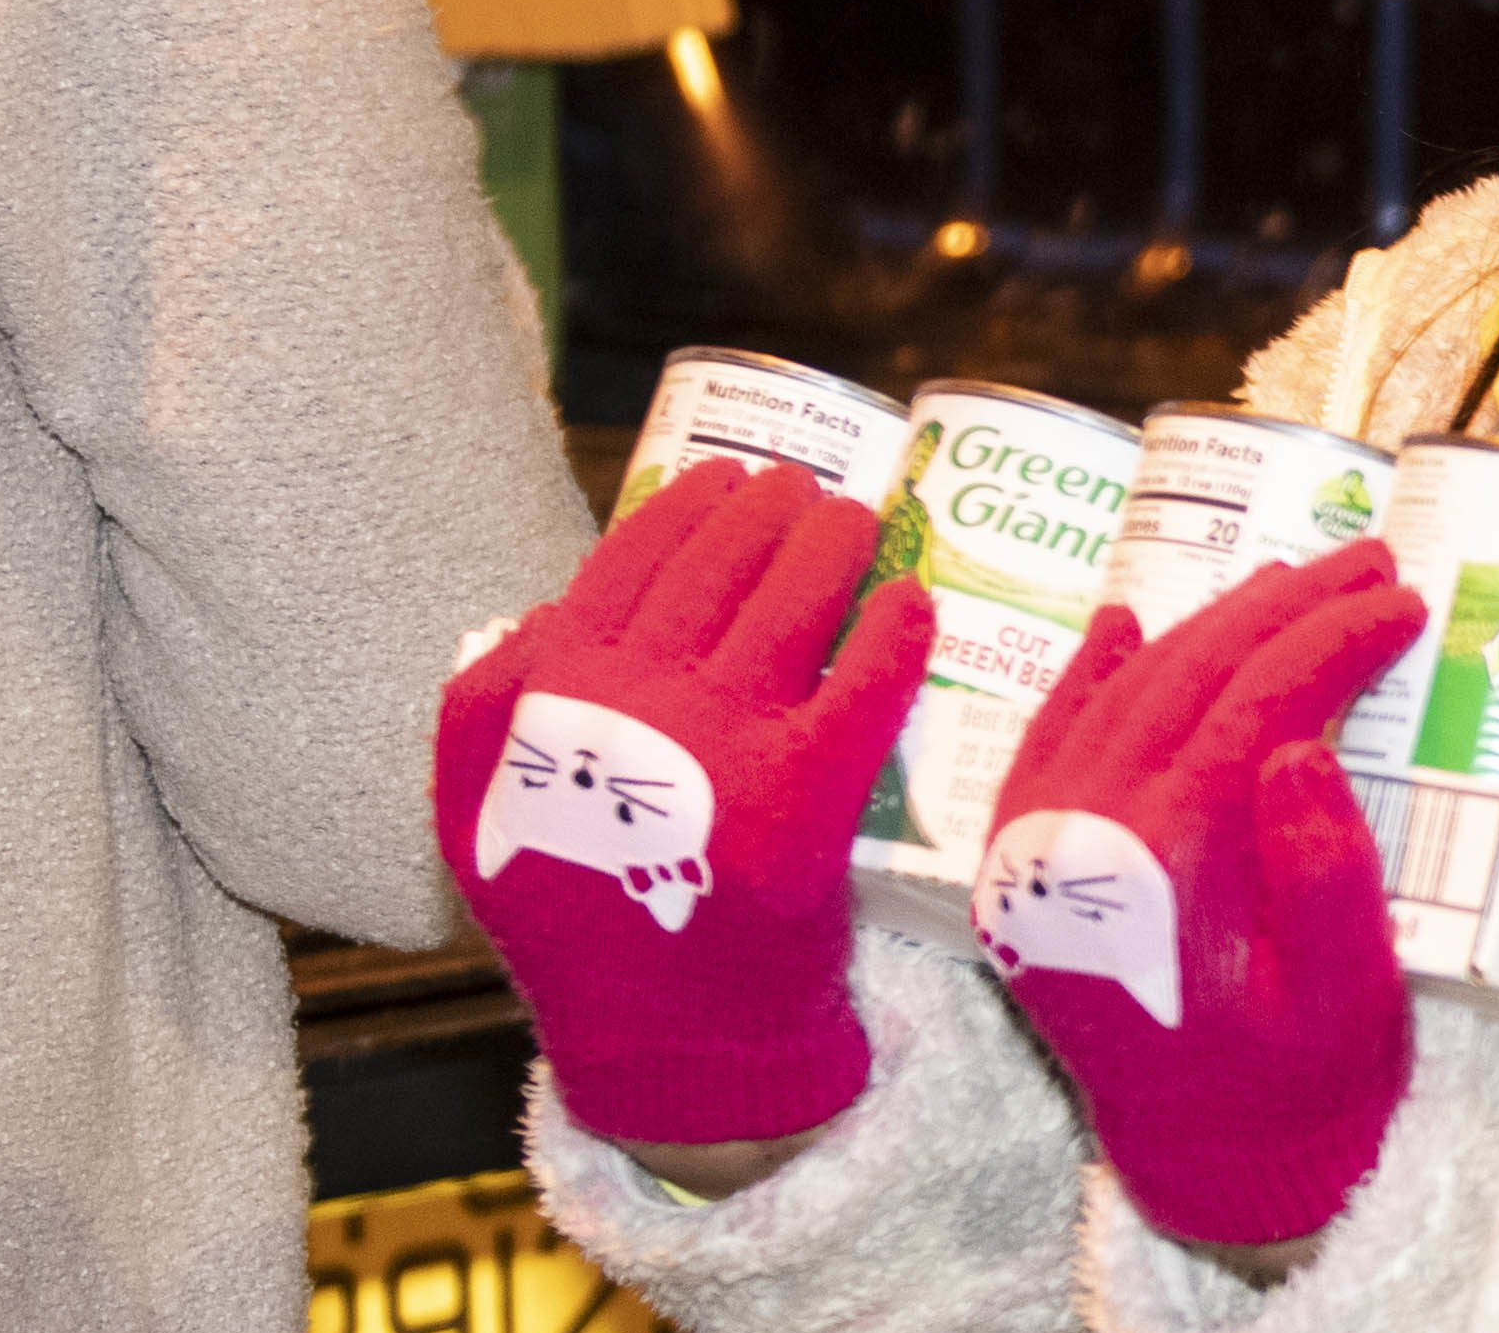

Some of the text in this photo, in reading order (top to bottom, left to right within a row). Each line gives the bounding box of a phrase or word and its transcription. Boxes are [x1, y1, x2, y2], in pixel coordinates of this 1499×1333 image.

[704, 380, 794, 413] Nutrition
[801, 402, 861, 438] Facts
[950, 425, 1128, 514] Green
[1205, 438, 1263, 465] Facts
[950, 482, 1112, 567] Giant
[1206, 518, 1240, 546] 20
[937, 635, 1056, 693] REEN BE
[998, 626, 1052, 660] CUT
